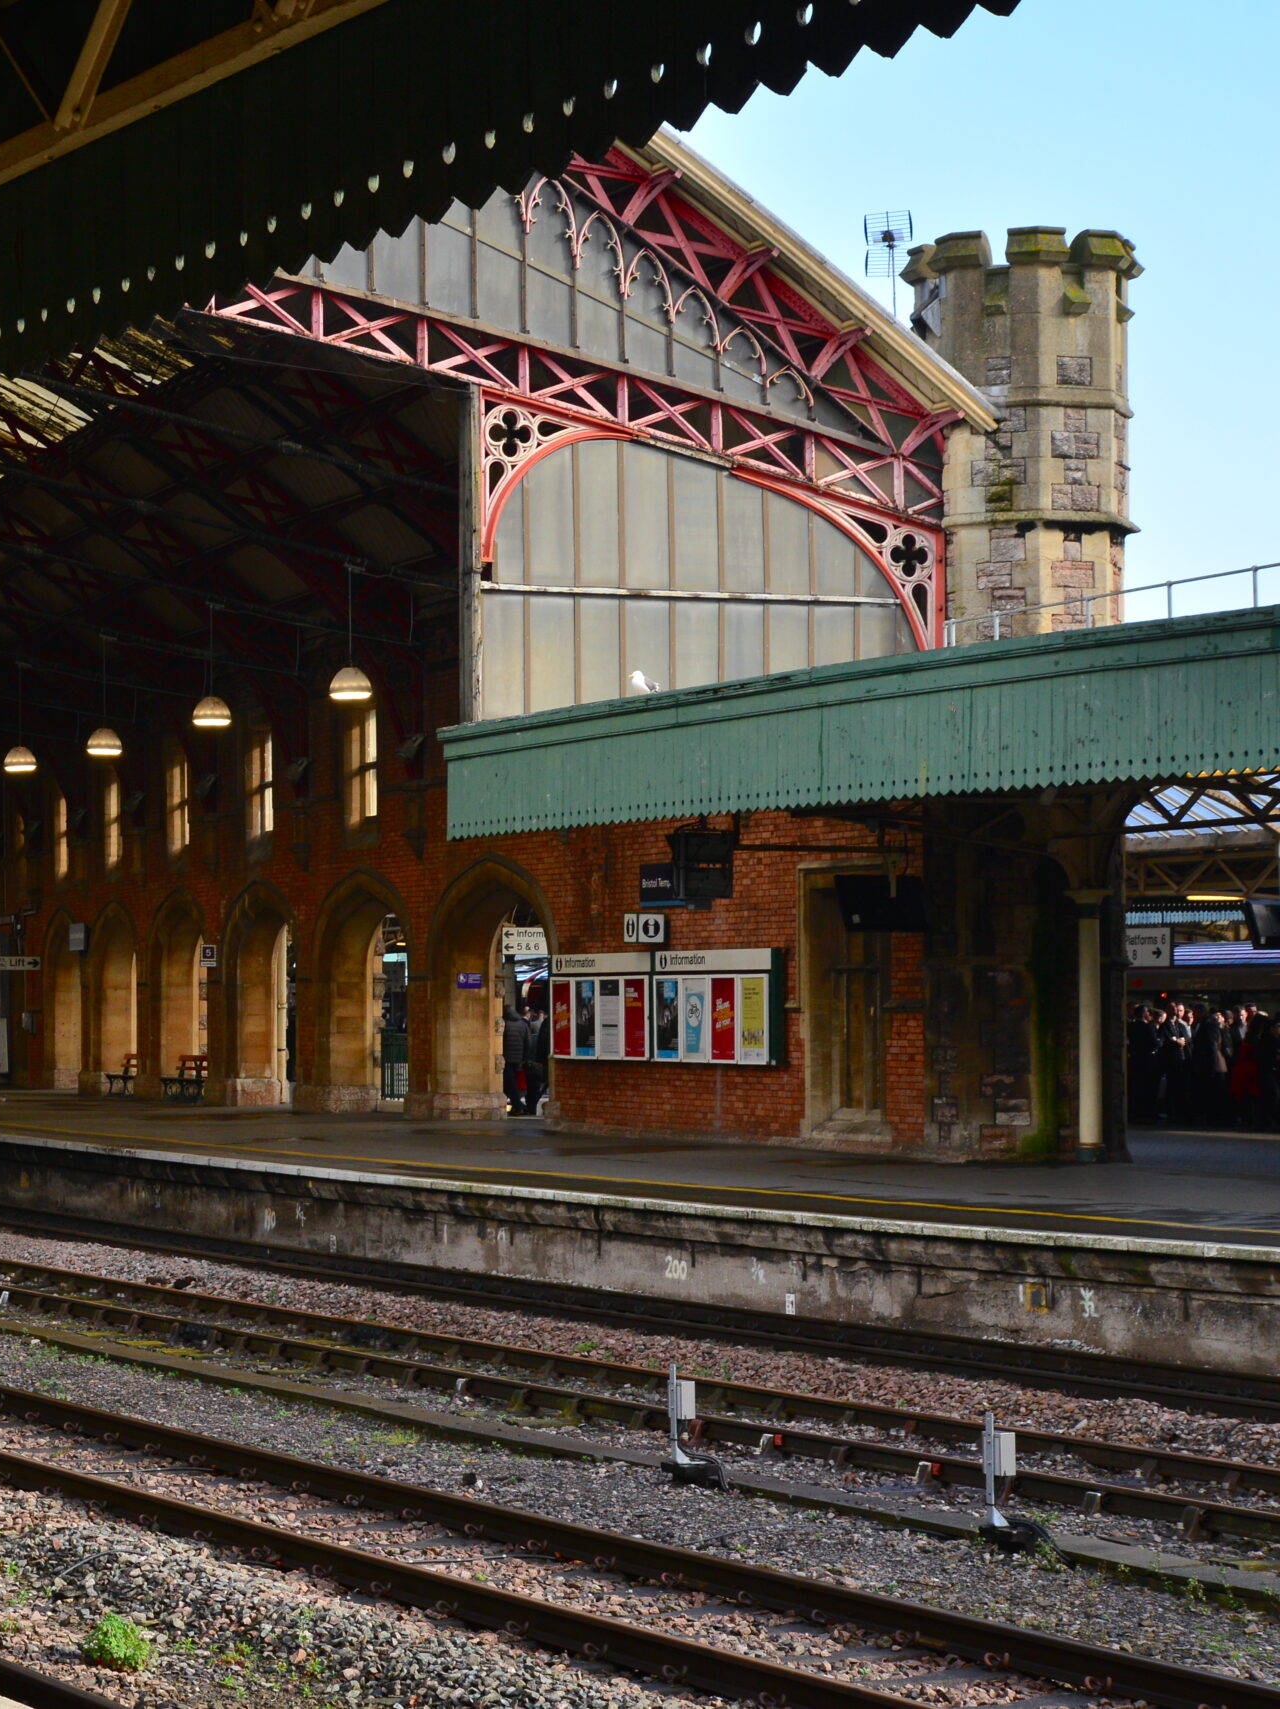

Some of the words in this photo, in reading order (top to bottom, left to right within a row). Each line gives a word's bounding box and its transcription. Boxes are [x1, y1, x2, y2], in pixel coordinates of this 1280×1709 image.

[642, 879, 657, 889] Bristol
[516, 929, 544, 938] Inform
[1161, 934, 1166, 945] 6
[516, 942, 523, 951] 5
[525, 942, 531, 951] &
[533, 942, 540, 951] 6
[205, 948, 212, 957] 5
[9, 958, 25, 967] Lift
[564, 956, 596, 969] Information
[669, 953, 706, 966] Information
[665, 1255, 688, 1280] 200
